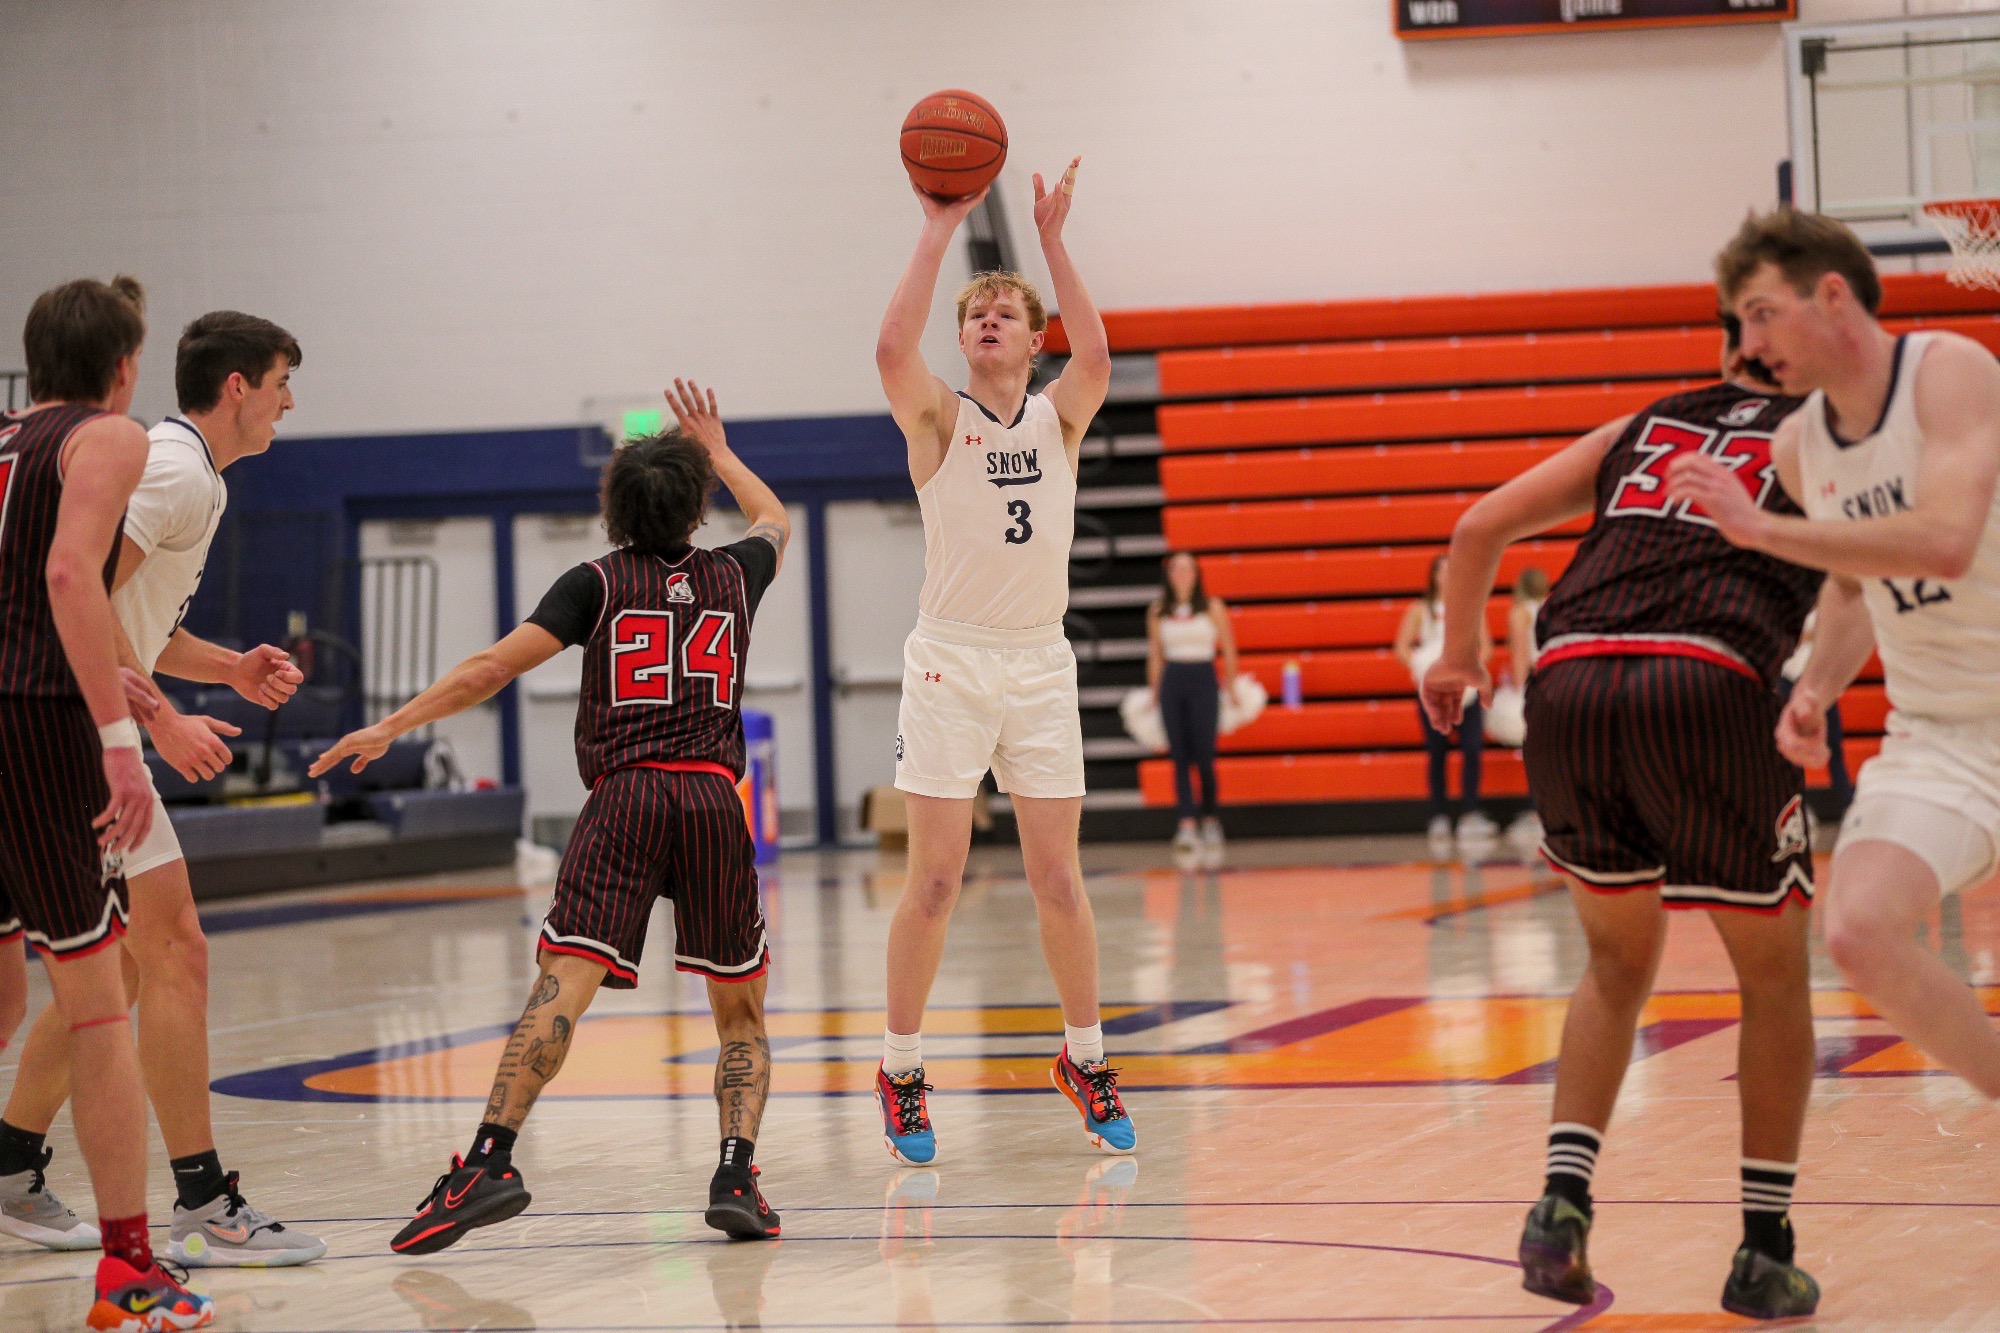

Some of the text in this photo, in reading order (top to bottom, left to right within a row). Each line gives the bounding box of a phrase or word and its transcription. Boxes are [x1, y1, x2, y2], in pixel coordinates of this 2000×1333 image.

[986, 448, 1038, 475] SNOW
[1005, 499, 1033, 545] 3
[611, 609, 737, 710] 24
